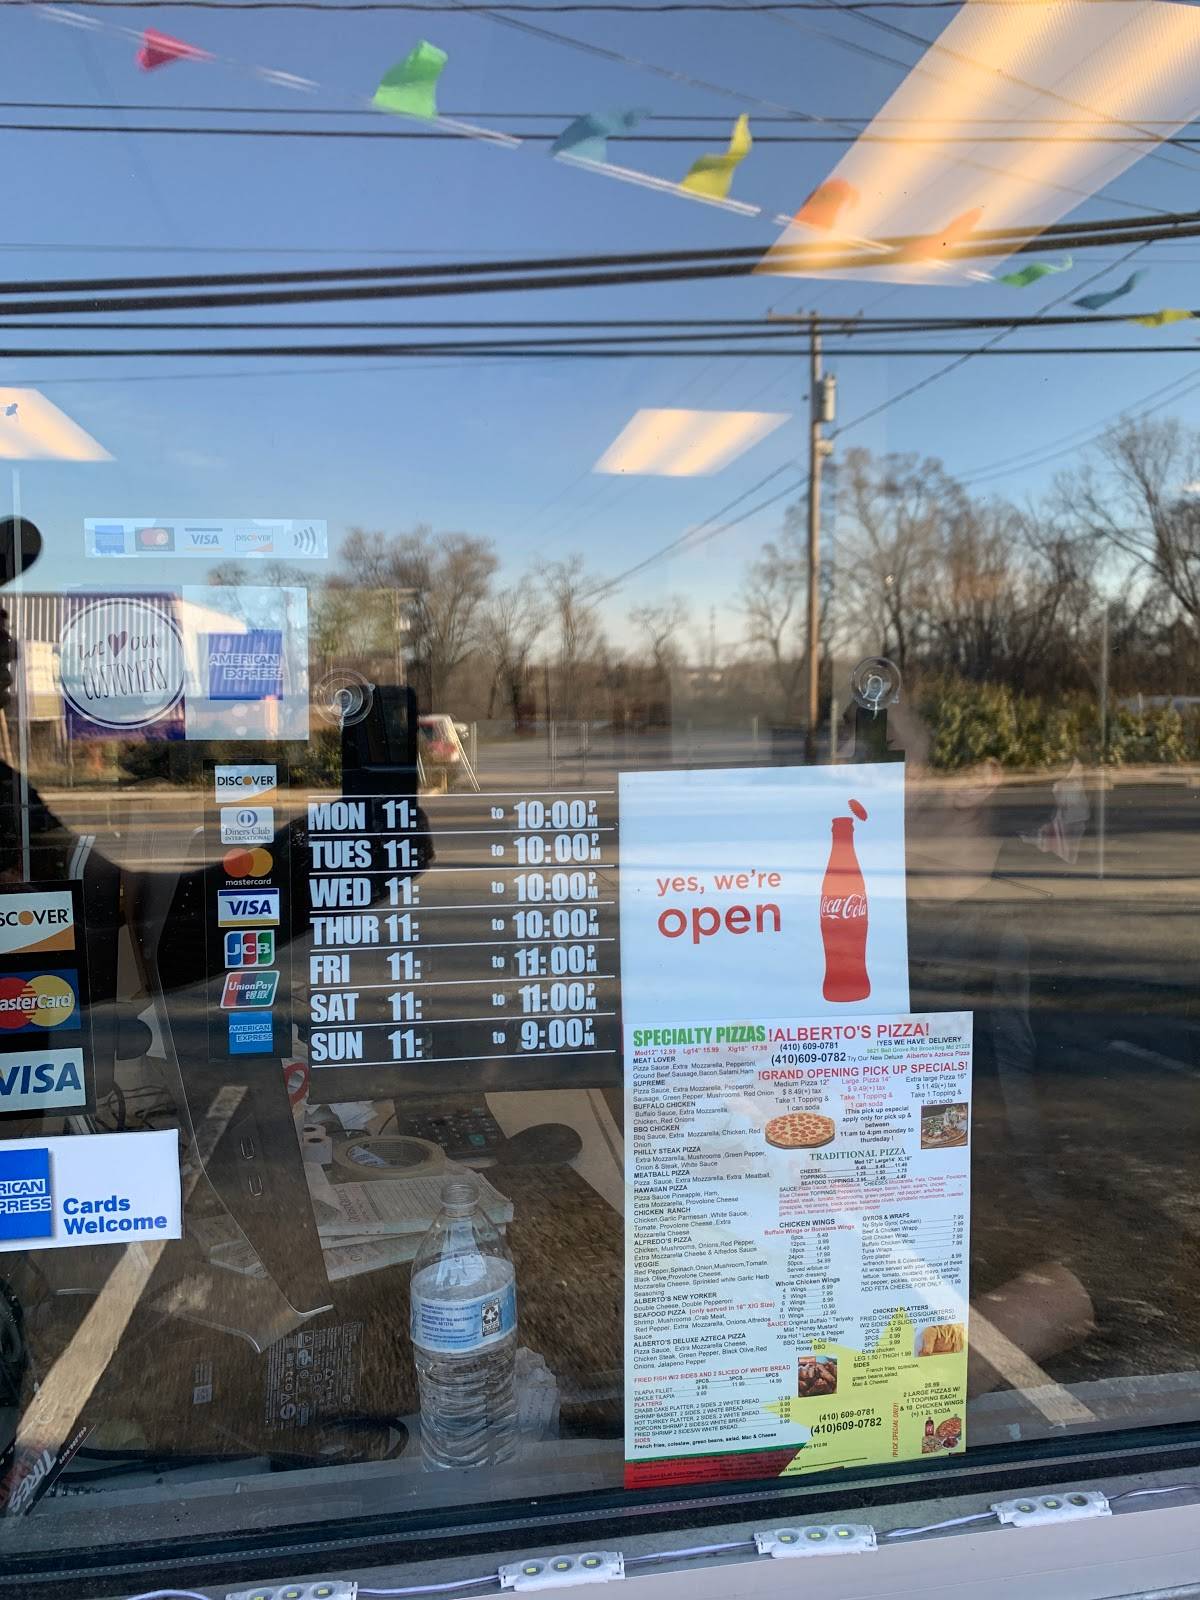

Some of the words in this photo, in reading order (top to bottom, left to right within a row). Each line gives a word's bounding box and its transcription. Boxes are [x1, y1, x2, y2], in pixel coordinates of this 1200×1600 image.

[192, 534, 219, 545] VISA
[236, 534, 272, 542] DISCOVER
[209, 654, 279, 664] AMERICAN
[82, 657, 168, 700] CUSTOMERS
[224, 669, 284, 680] EXPRESS
[218, 776, 274, 785] DISCOVER
[308, 802, 365, 830] MON
[382, 800, 417, 828] 11:
[491, 807, 504, 819] to
[514, 800, 586, 829] 10:00
[309, 840, 372, 869] TUES
[384, 839, 418, 868] 11:
[491, 844, 504, 857] to
[514, 834, 589, 864] 10:00
[309, 878, 372, 908] WED
[385, 877, 419, 905] 11:
[491, 881, 504, 893] to
[514, 872, 587, 902] 10:00
[656, 876, 705, 896] yes,
[714, 869, 782, 890] we're
[227, 900, 272, 915] VISA
[310, 915, 379, 945] THUR
[385, 914, 419, 942] 11:
[492, 919, 504, 931] to
[512, 908, 587, 939] 10:00
[657, 903, 781, 944] open
[228, 943, 270, 955] JCB
[310, 955, 350, 985] FRI
[387, 952, 421, 981] 11:
[492, 955, 504, 968] to
[229, 981, 273, 991] UnionPay
[310, 993, 359, 1023] SAT
[388, 992, 422, 1021] 11:
[492, 993, 505, 1006] to
[237, 1033, 273, 1042] EXPRESS
[633, 1027, 712, 1047] SPECIALTY
[716, 1025, 765, 1043] PIZZAS
[877, 1023, 929, 1038] PIZZA!
[311, 1031, 363, 1061] SUN
[388, 1029, 423, 1059] 11:
[493, 1032, 505, 1044] to
[521, 1018, 583, 1050] 9:00
[780, 1043, 800, 1052] (410)
[803, 1042, 838, 1050] 609-0781
[807, 1066, 859, 1078] OPENING
[863, 1066, 888, 1075] PICK
[893, 1065, 907, 1074] UP
[911, 1061, 967, 1073] SPECIALS!
[0, 1063, 81, 1095] VISA
[809, 1150, 878, 1161] TRADITIONAL
[879, 1148, 906, 1157] PIZZA
[634, 1171, 669, 1179] MEATBALL
[634, 1186, 667, 1194] HAWAIIAN
[63, 1197, 131, 1215] Cards
[64, 1216, 167, 1235] Welcome
[779, 1220, 810, 1228] CHICKEN
[811, 1218, 835, 1226] WINGS
[634, 1238, 672, 1246] ALFREDO'S
[634, 1311, 666, 1319] SEAFOOD
[634, 1339, 671, 1347] ALBERTO'S
[673, 1337, 699, 1345] DELUXE
[819, 1412, 838, 1421] (410)
[841, 1408, 875, 1418] 609-0781
[810, 1417, 882, 1437] (410)609-0782
